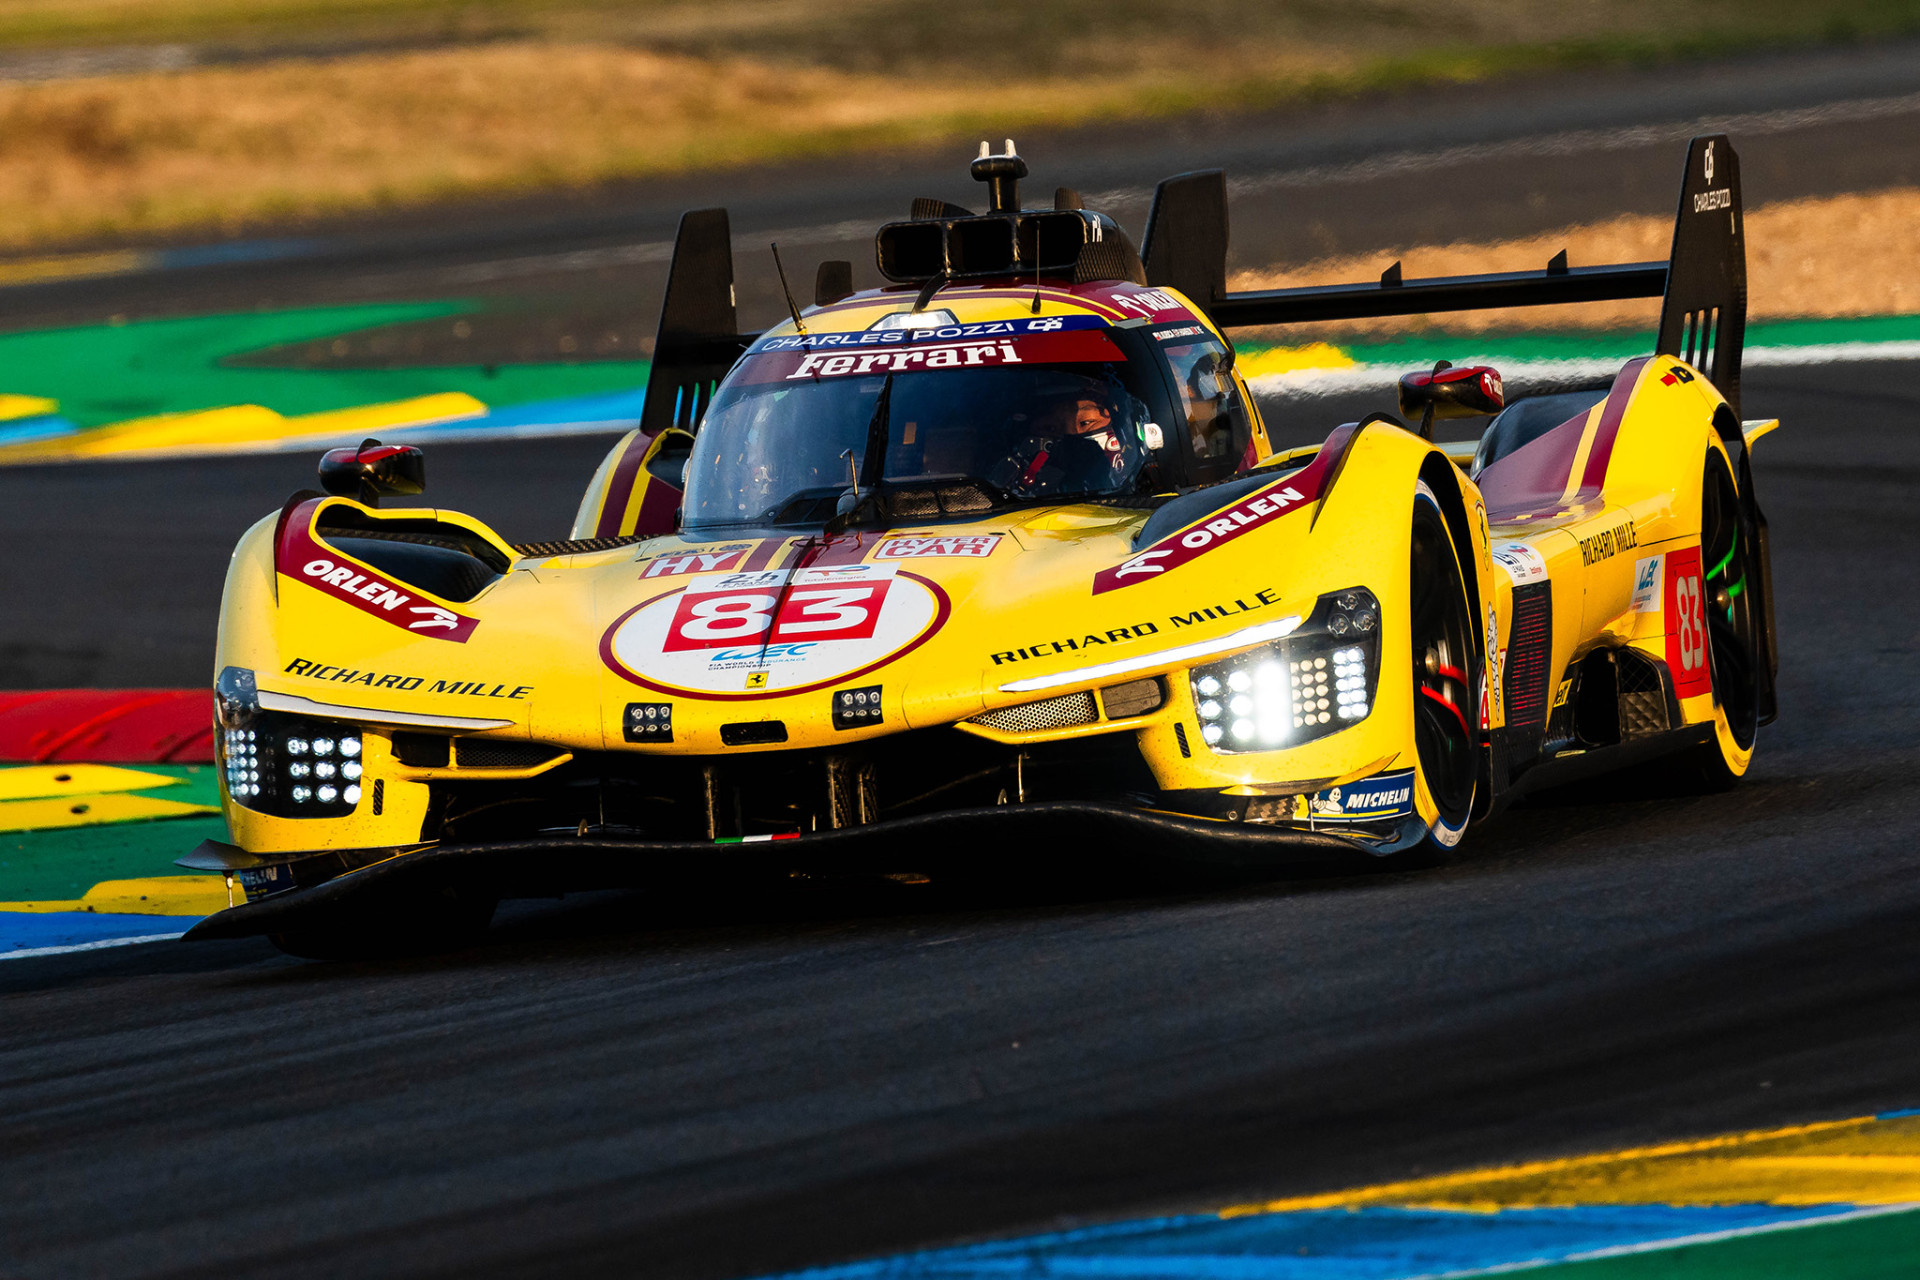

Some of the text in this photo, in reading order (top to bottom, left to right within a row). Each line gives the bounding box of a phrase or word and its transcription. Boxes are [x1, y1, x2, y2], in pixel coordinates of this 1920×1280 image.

[1133, 290, 1182, 311] ORLEN
[761, 331, 902, 351] CHARLES
[912, 322, 1014, 341] POZZI
[786, 339, 1022, 379] Ferrari
[1181, 486, 1305, 549] ORLEN
[885, 544, 985, 556] CAR
[891, 537, 991, 546] HYPER
[1579, 521, 1638, 567] RICHARD MILLE
[644, 551, 740, 578] HY
[303, 560, 410, 611] ORLEN
[681, 586, 875, 640] 83
[990, 588, 1282, 665] RICHARD MILLE
[1676, 575, 1704, 671] 83
[711, 642, 818, 661] WEC
[284, 657, 534, 699] RICHARD MILLE
[1346, 786, 1410, 809] MICHELIN
